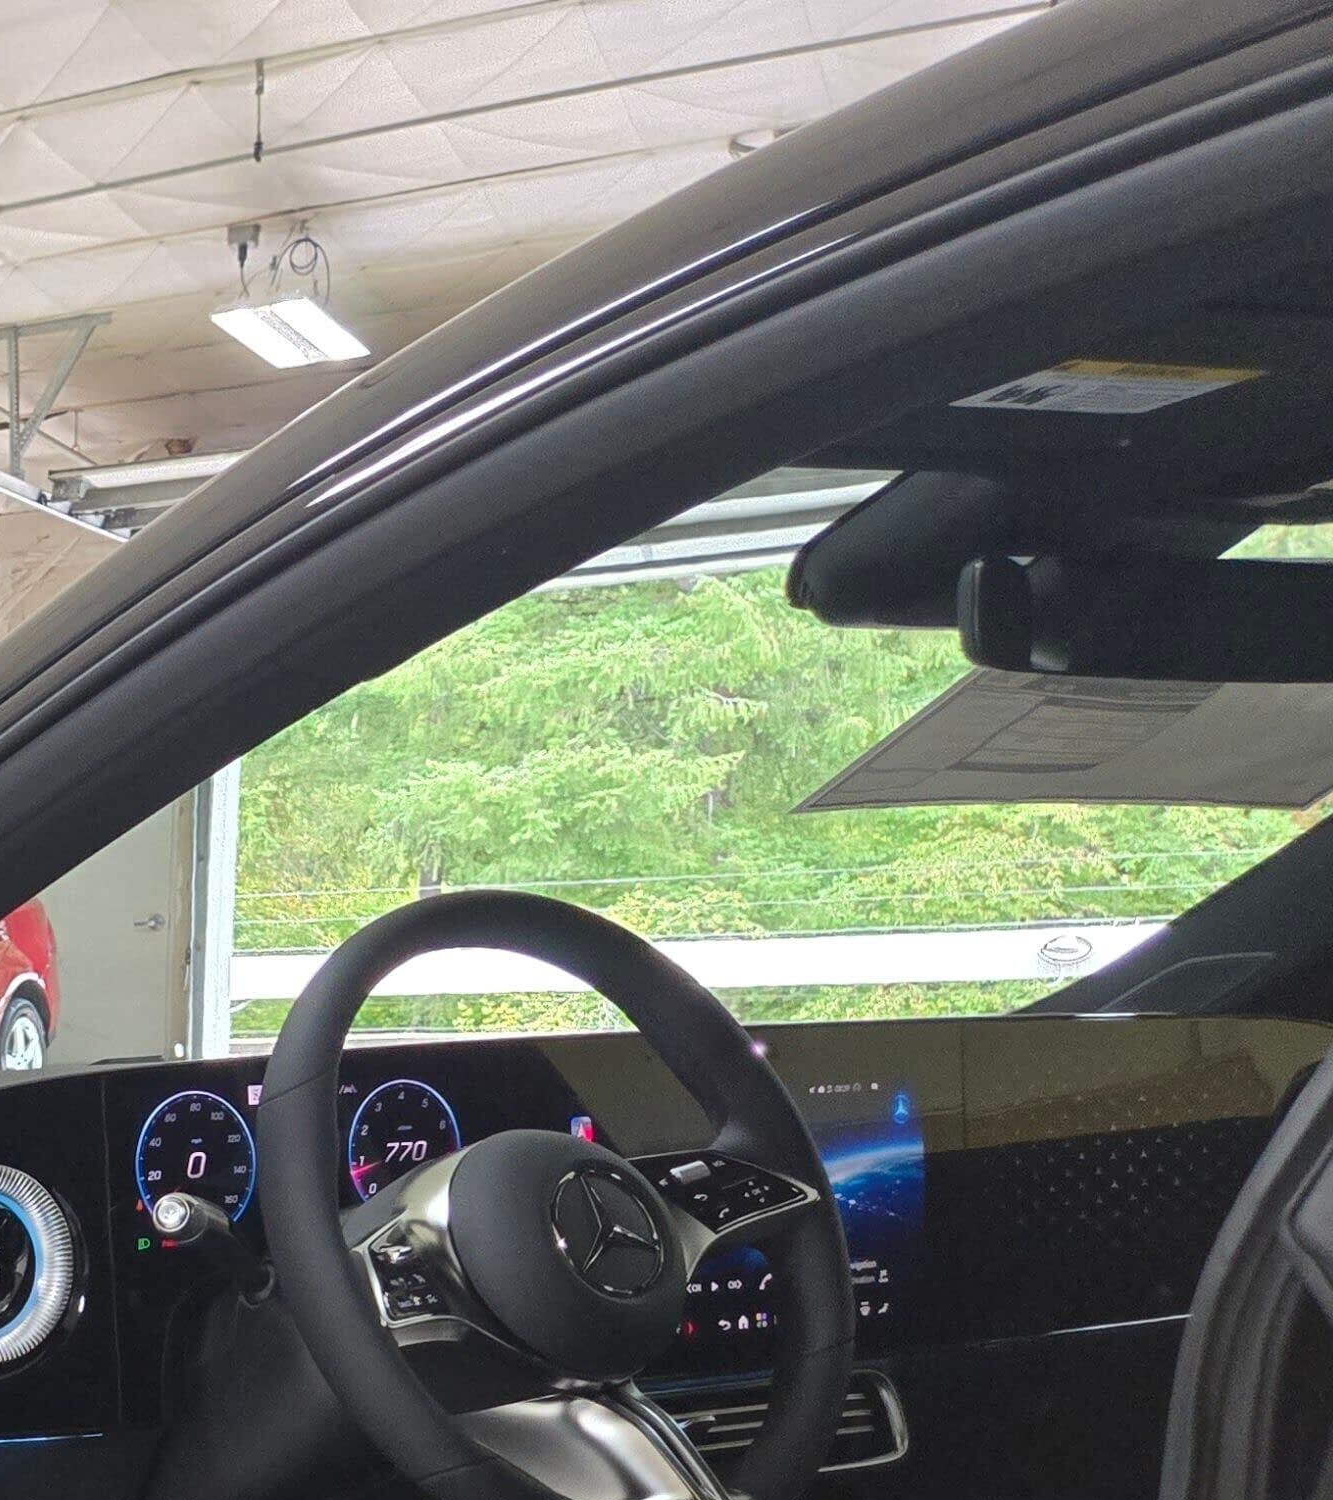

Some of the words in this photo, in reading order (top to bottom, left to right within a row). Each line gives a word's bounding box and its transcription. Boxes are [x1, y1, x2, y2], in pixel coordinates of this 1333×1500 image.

[398, 1091, 405, 1100] 4
[375, 1103, 382, 1113] 3
[421, 1098, 429, 1108] 5
[360, 1124, 369, 1136] 2
[439, 1120, 446, 1130] 6
[149, 1137, 162, 1147] 40
[384, 1140, 428, 1163] 770
[187, 1151, 207, 1179] 0
[147, 1170, 162, 1181] 20
[368, 1183, 377, 1194] 0
